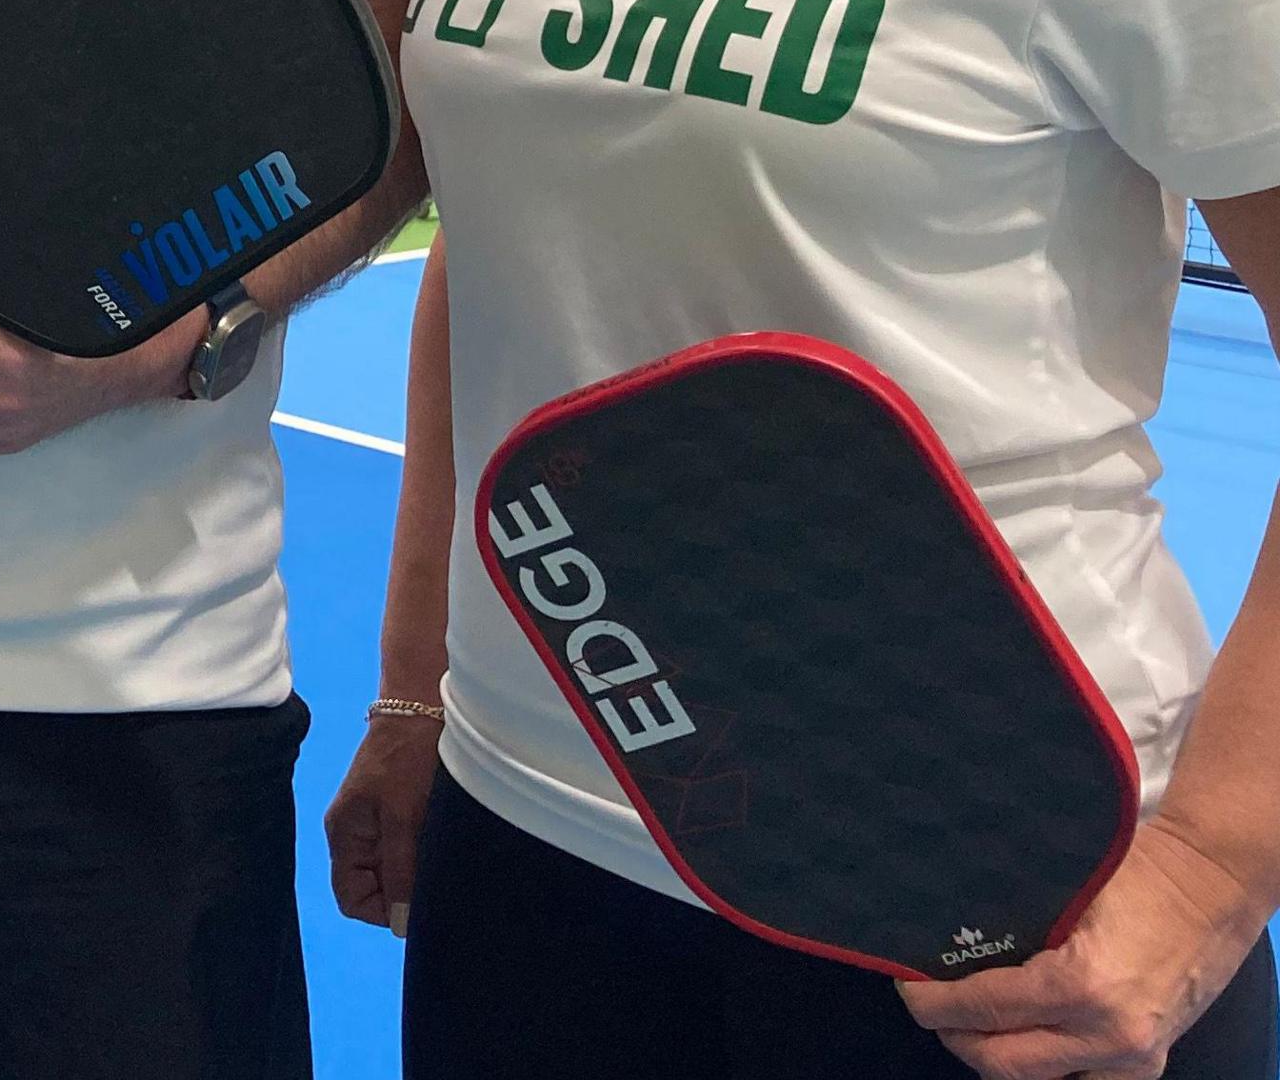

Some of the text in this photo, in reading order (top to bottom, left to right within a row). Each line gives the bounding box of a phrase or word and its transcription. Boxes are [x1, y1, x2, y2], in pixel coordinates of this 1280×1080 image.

[121, 150, 312, 306] VOLAIR
[86, 285, 132, 330] FORZA
[488, 483, 696, 753] EDGE
[941, 938, 1016, 966] DIADEM
